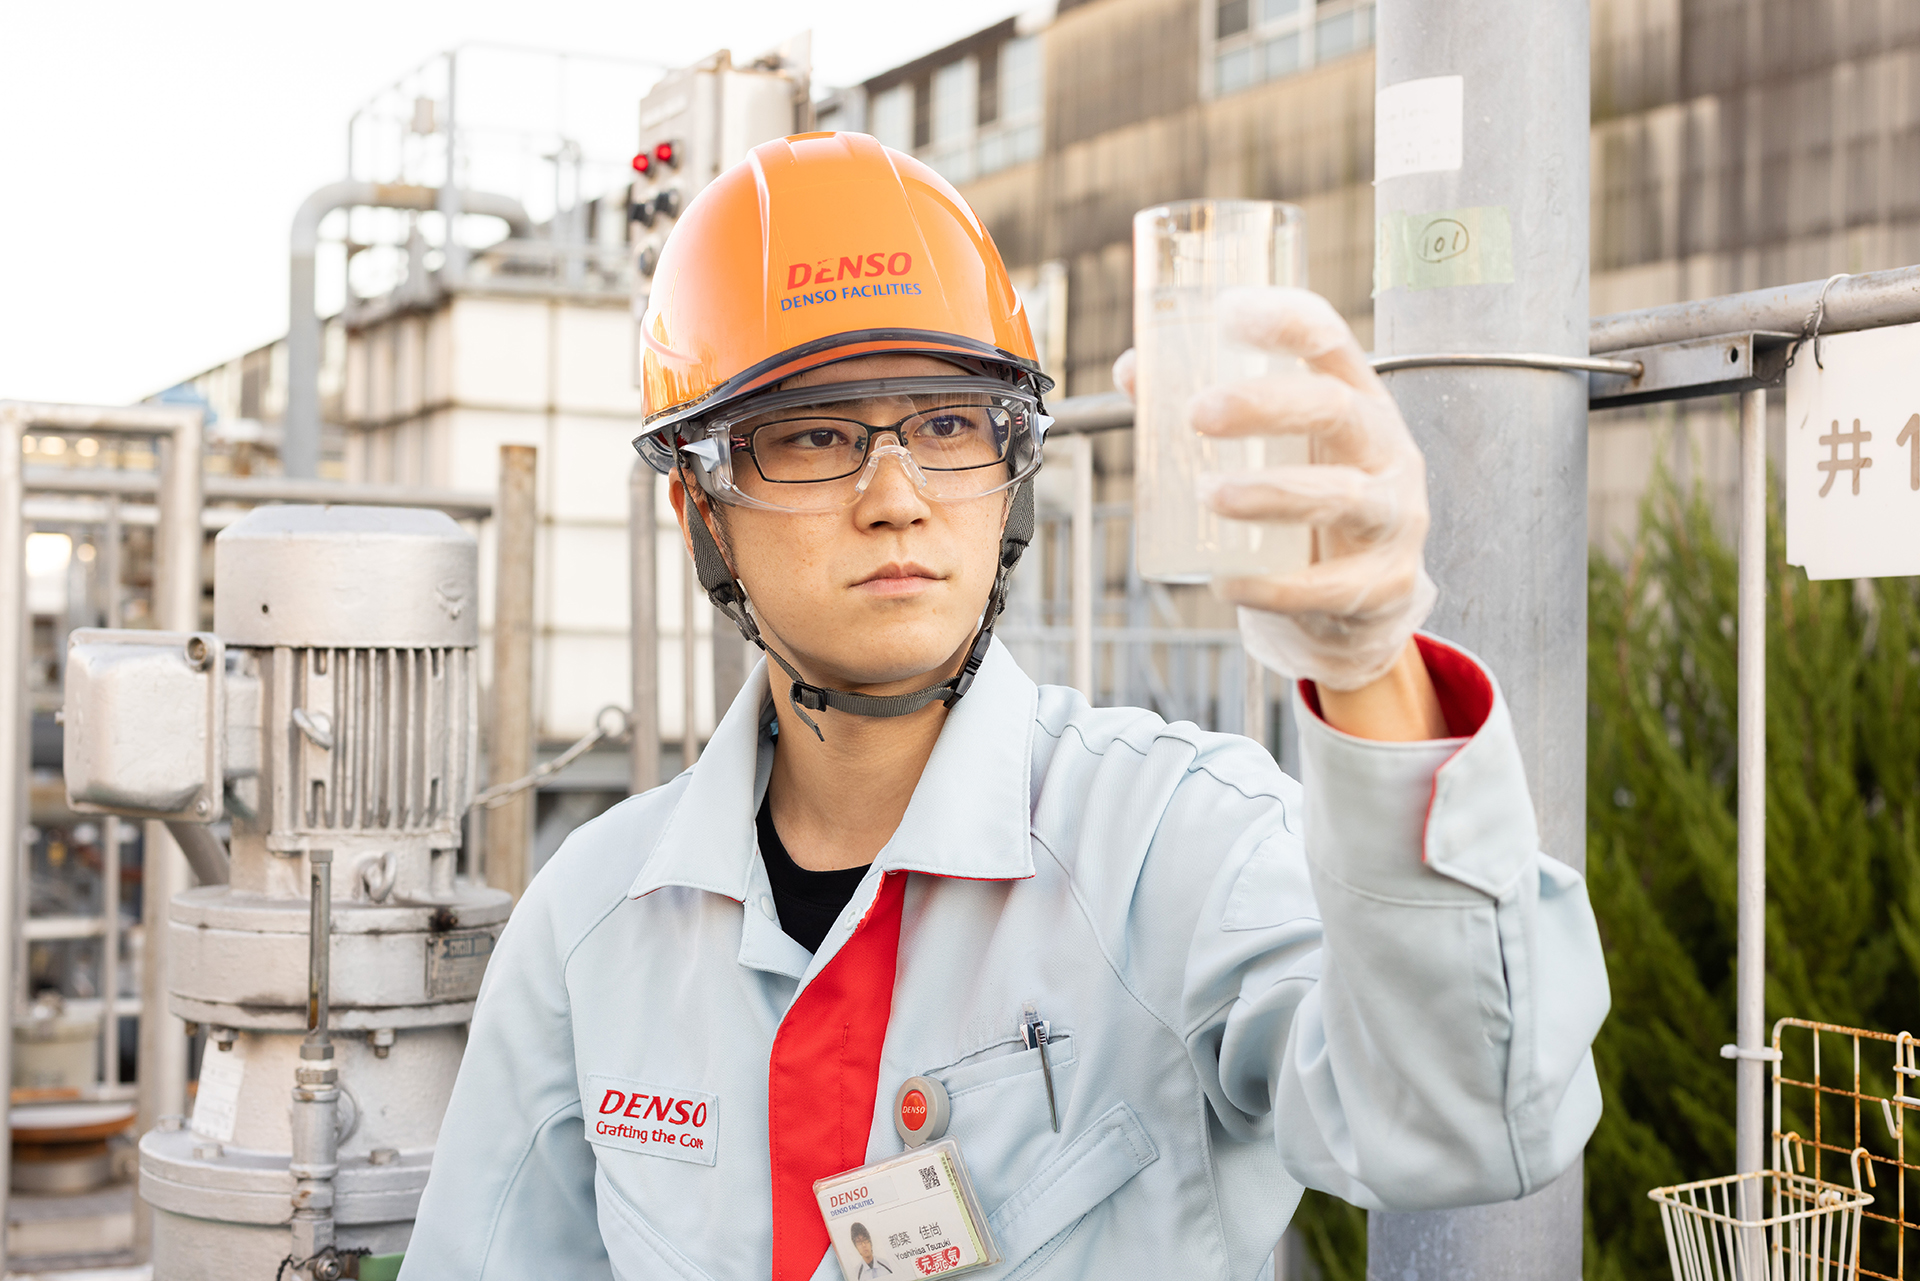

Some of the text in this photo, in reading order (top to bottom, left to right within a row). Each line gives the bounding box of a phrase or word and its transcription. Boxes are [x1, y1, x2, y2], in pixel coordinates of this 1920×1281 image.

[1423, 230, 1460, 258] 101
[787, 252, 912, 290] DENSO
[780, 283, 922, 312] DENSO FACILITIES
[599, 1089, 707, 1128] DENSO
[902, 1105, 926, 1114] DENSO
[596, 1120, 648, 1144] Crafting
[651, 1129, 676, 1144] the
[830, 1186, 868, 1208] DENSO
[830, 1206, 848, 1217] DENSO
[925, 1238, 951, 1251] Tsuzuki
